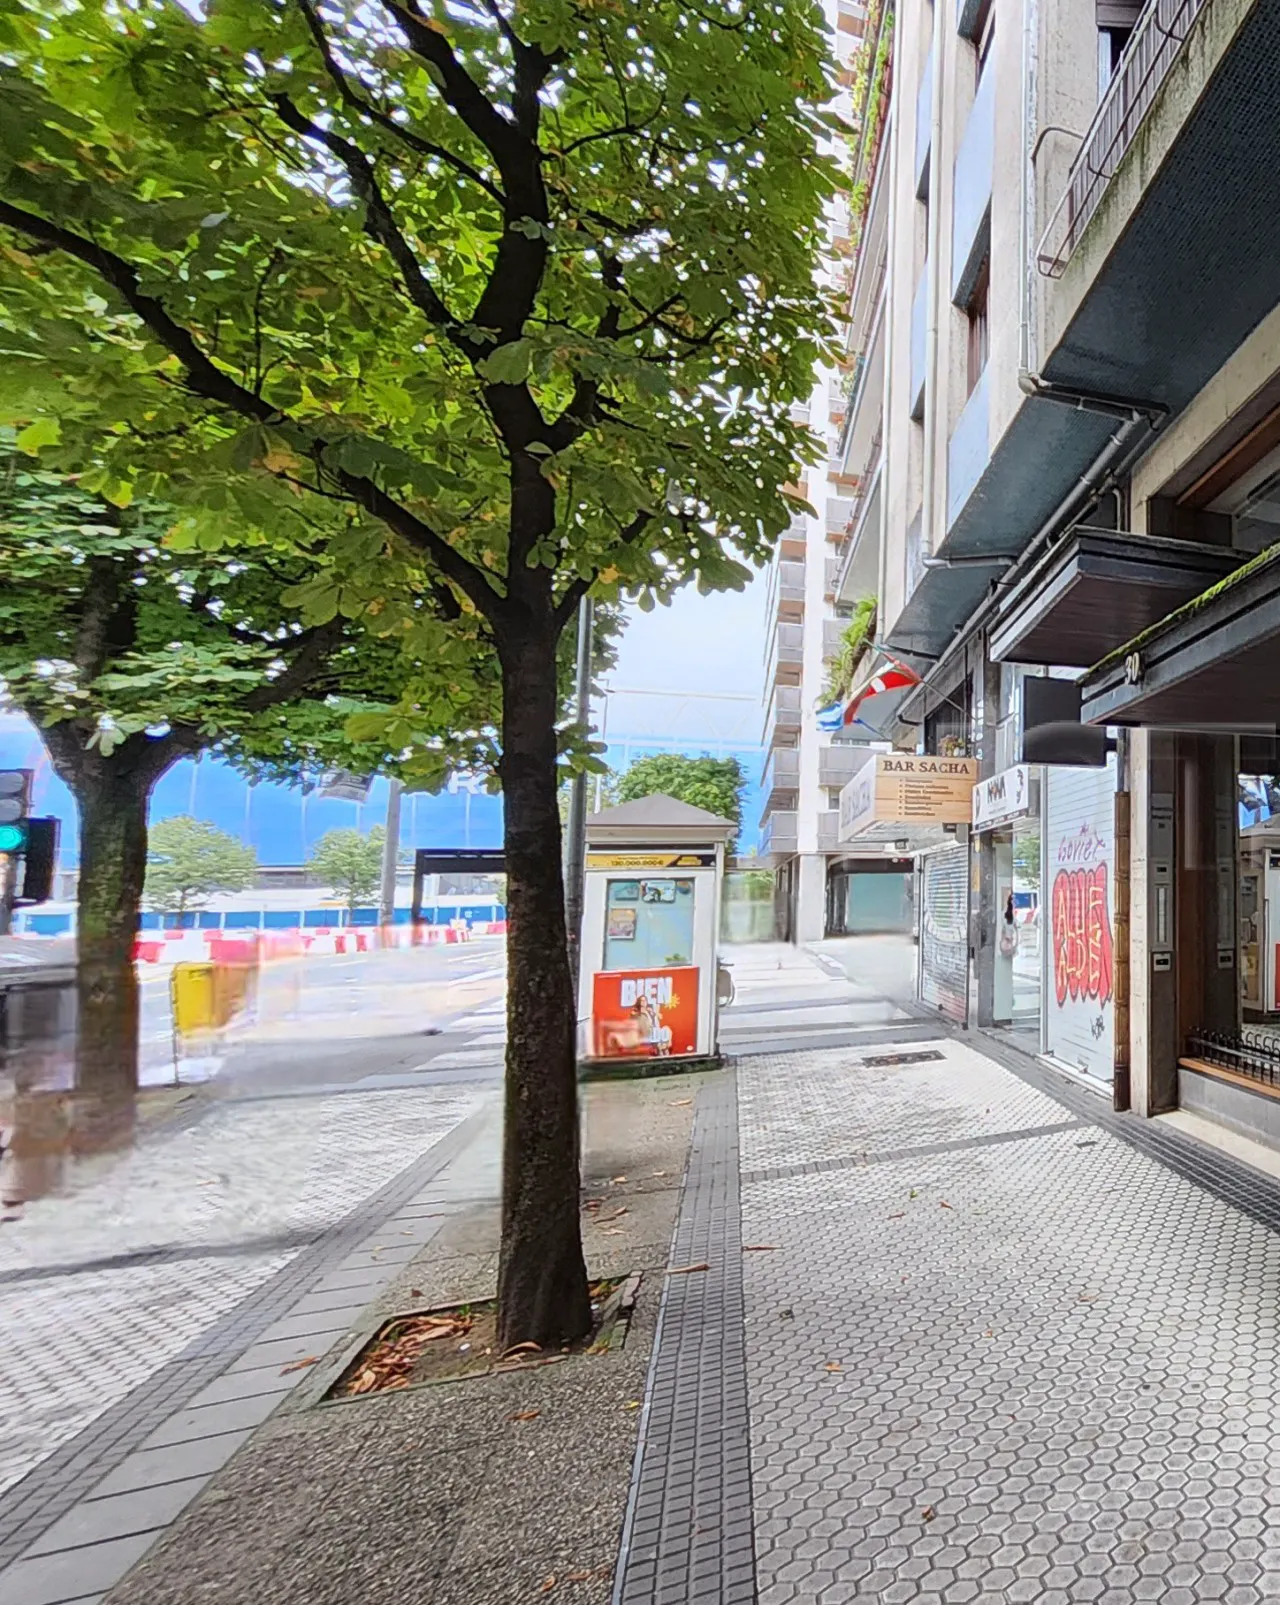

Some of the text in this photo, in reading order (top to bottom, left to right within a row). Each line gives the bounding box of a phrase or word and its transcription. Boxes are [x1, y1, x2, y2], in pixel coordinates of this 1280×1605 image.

[1125, 652, 1139, 685] 30
[883, 760, 970, 774] BAR SACHA
[620, 976, 673, 1007] BIEN
